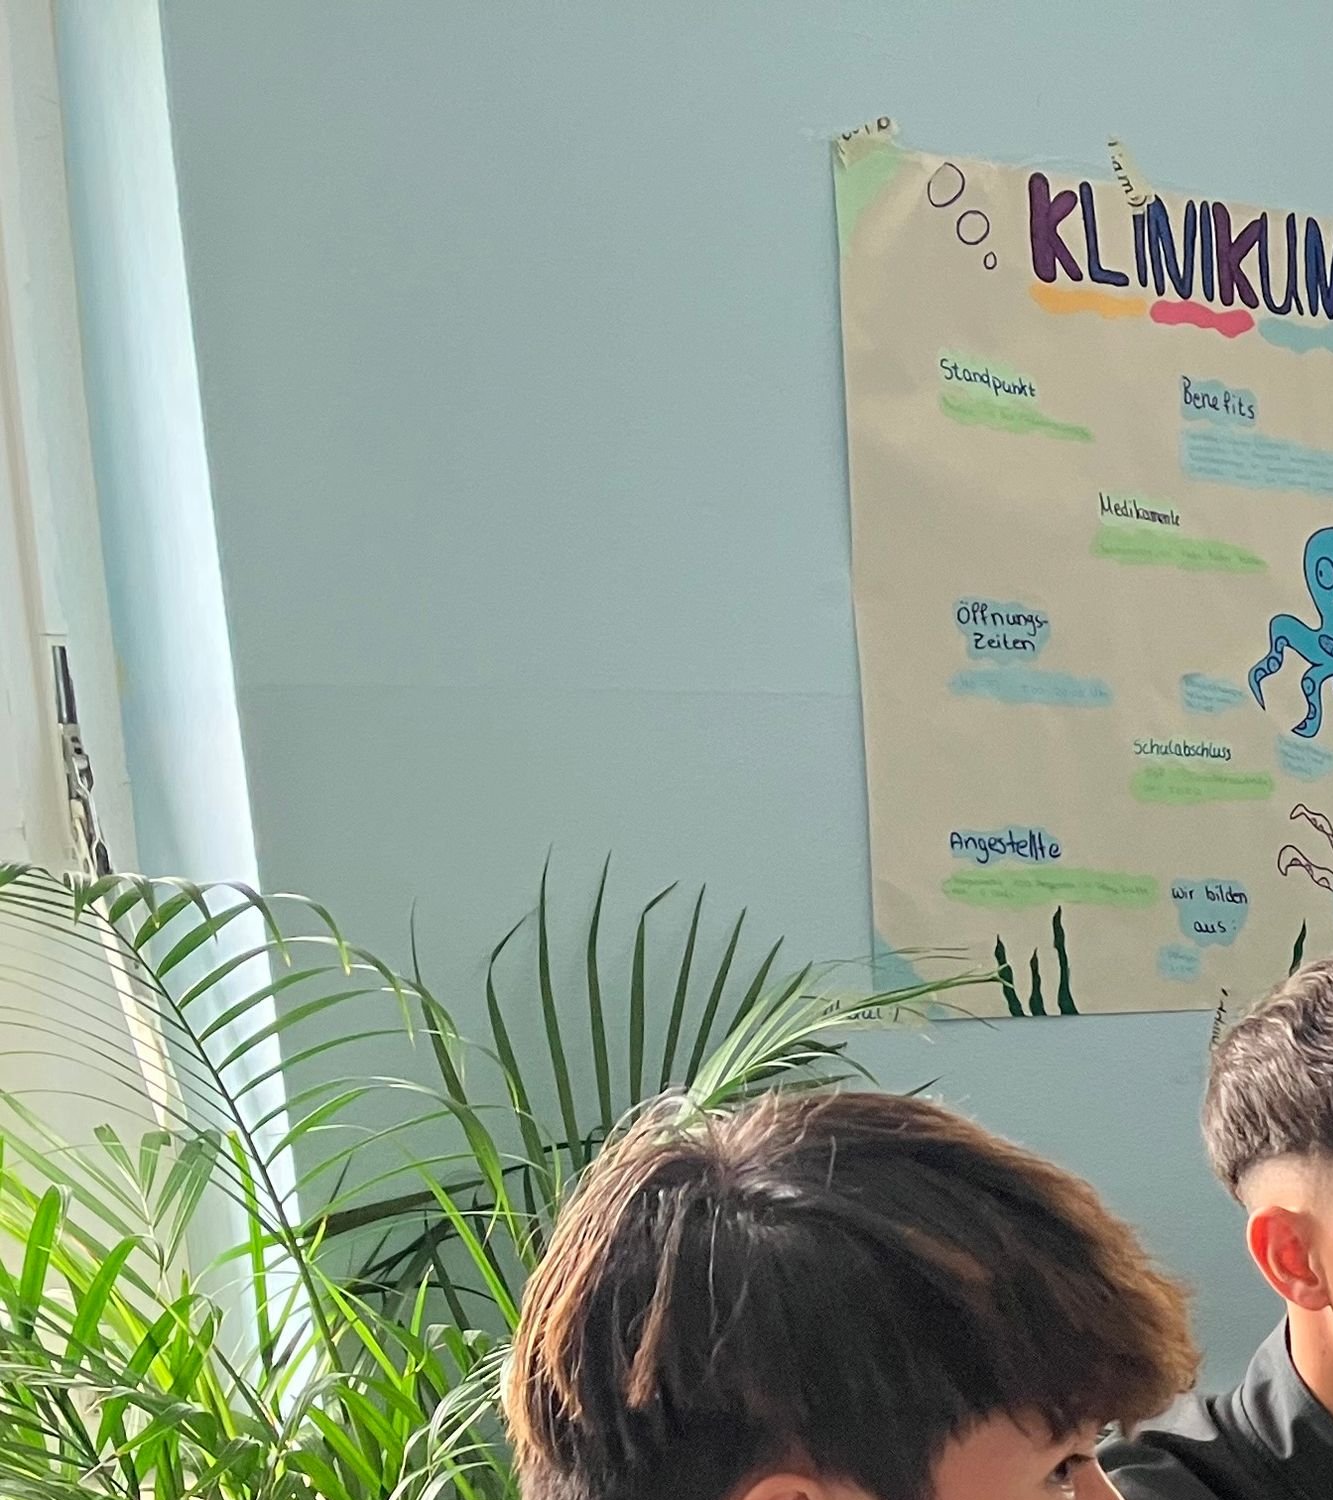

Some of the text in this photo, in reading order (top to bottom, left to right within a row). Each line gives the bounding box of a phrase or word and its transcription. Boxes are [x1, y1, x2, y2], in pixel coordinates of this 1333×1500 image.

[940, 358, 1036, 397] Standpunkt
[1181, 376, 1255, 419] Benefits
[1099, 491, 1180, 527] Medikamente
[957, 600, 1049, 637] Öffnungs-
[973, 632, 1036, 652] Zeiten
[1133, 738, 1232, 762] Schulabschluss
[950, 830, 1062, 865] Angestellte
[1204, 884, 1248, 904] bilden
